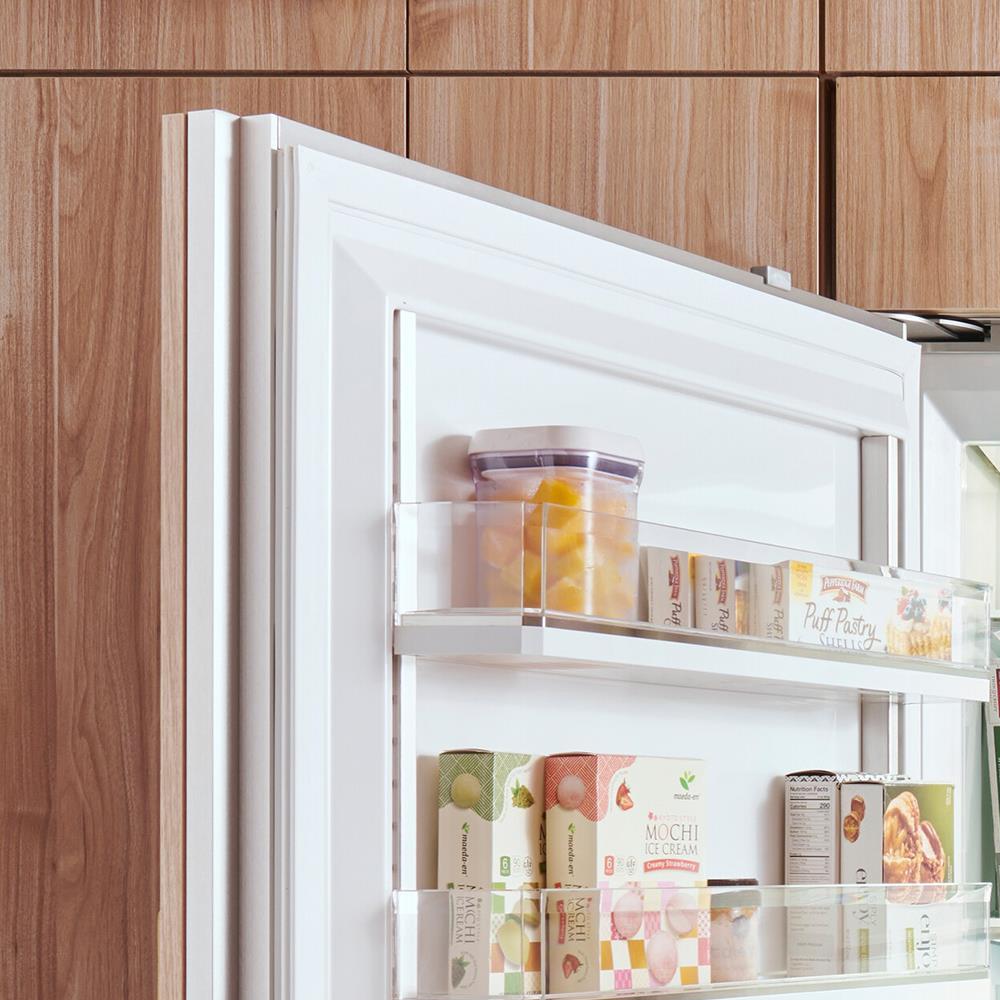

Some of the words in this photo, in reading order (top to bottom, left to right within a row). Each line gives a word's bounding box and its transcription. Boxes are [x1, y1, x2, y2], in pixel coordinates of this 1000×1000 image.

[803, 601, 834, 633] Puff
[834, 606, 882, 651] Pastry
[645, 823, 699, 841] MOCHI
[645, 842, 660, 855] ICE
[662, 842, 699, 855] CREAM
